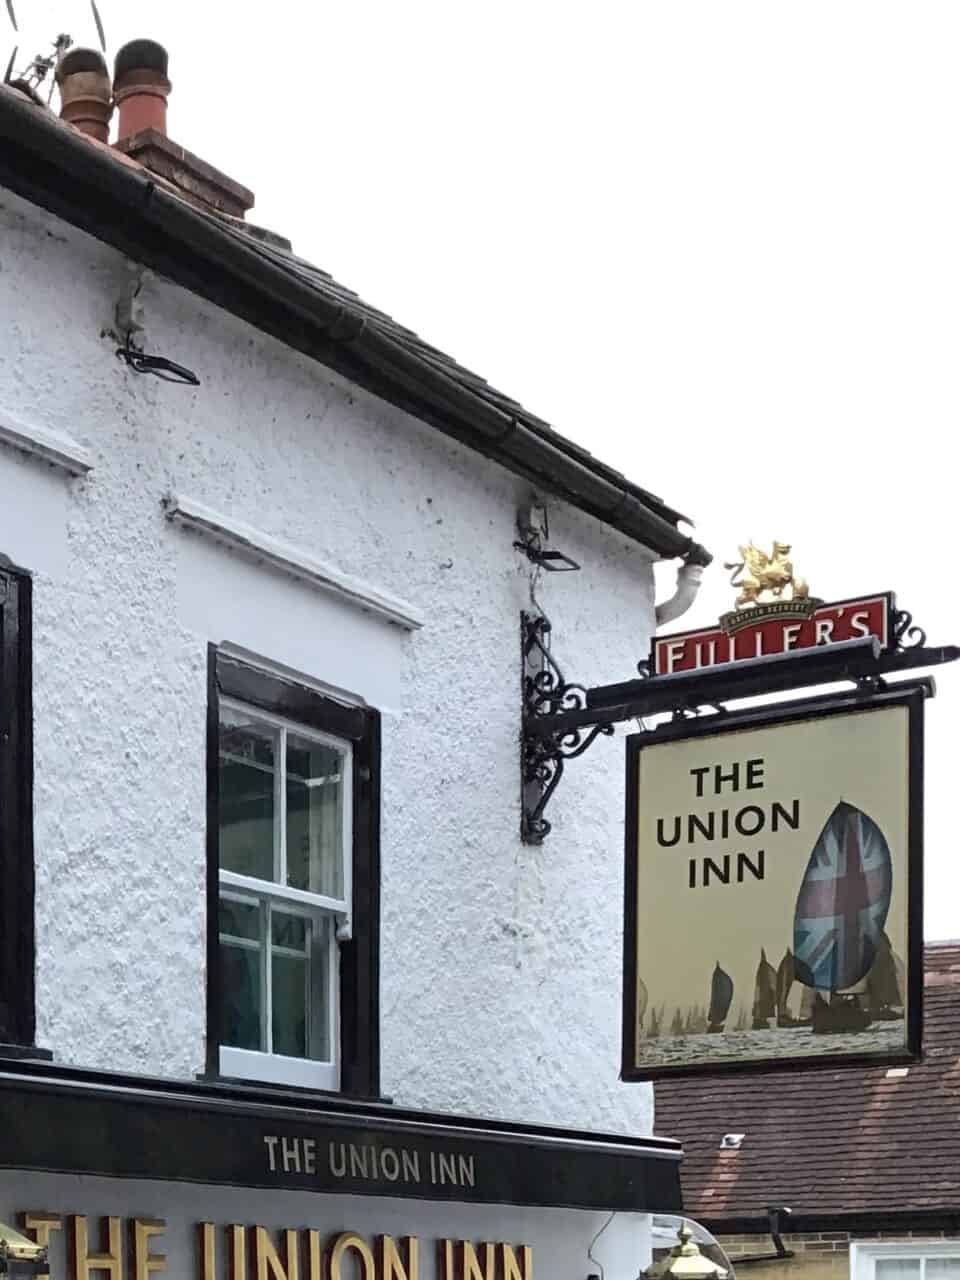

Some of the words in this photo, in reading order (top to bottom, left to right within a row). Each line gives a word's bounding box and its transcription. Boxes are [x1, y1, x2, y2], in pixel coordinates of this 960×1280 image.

[690, 759, 764, 797] THE
[656, 800, 800, 848] UNION
[689, 850, 765, 888] INN
[264, 1135, 316, 1175] THE
[329, 1141, 420, 1184] UNION
[430, 1148, 476, 1188] INN
